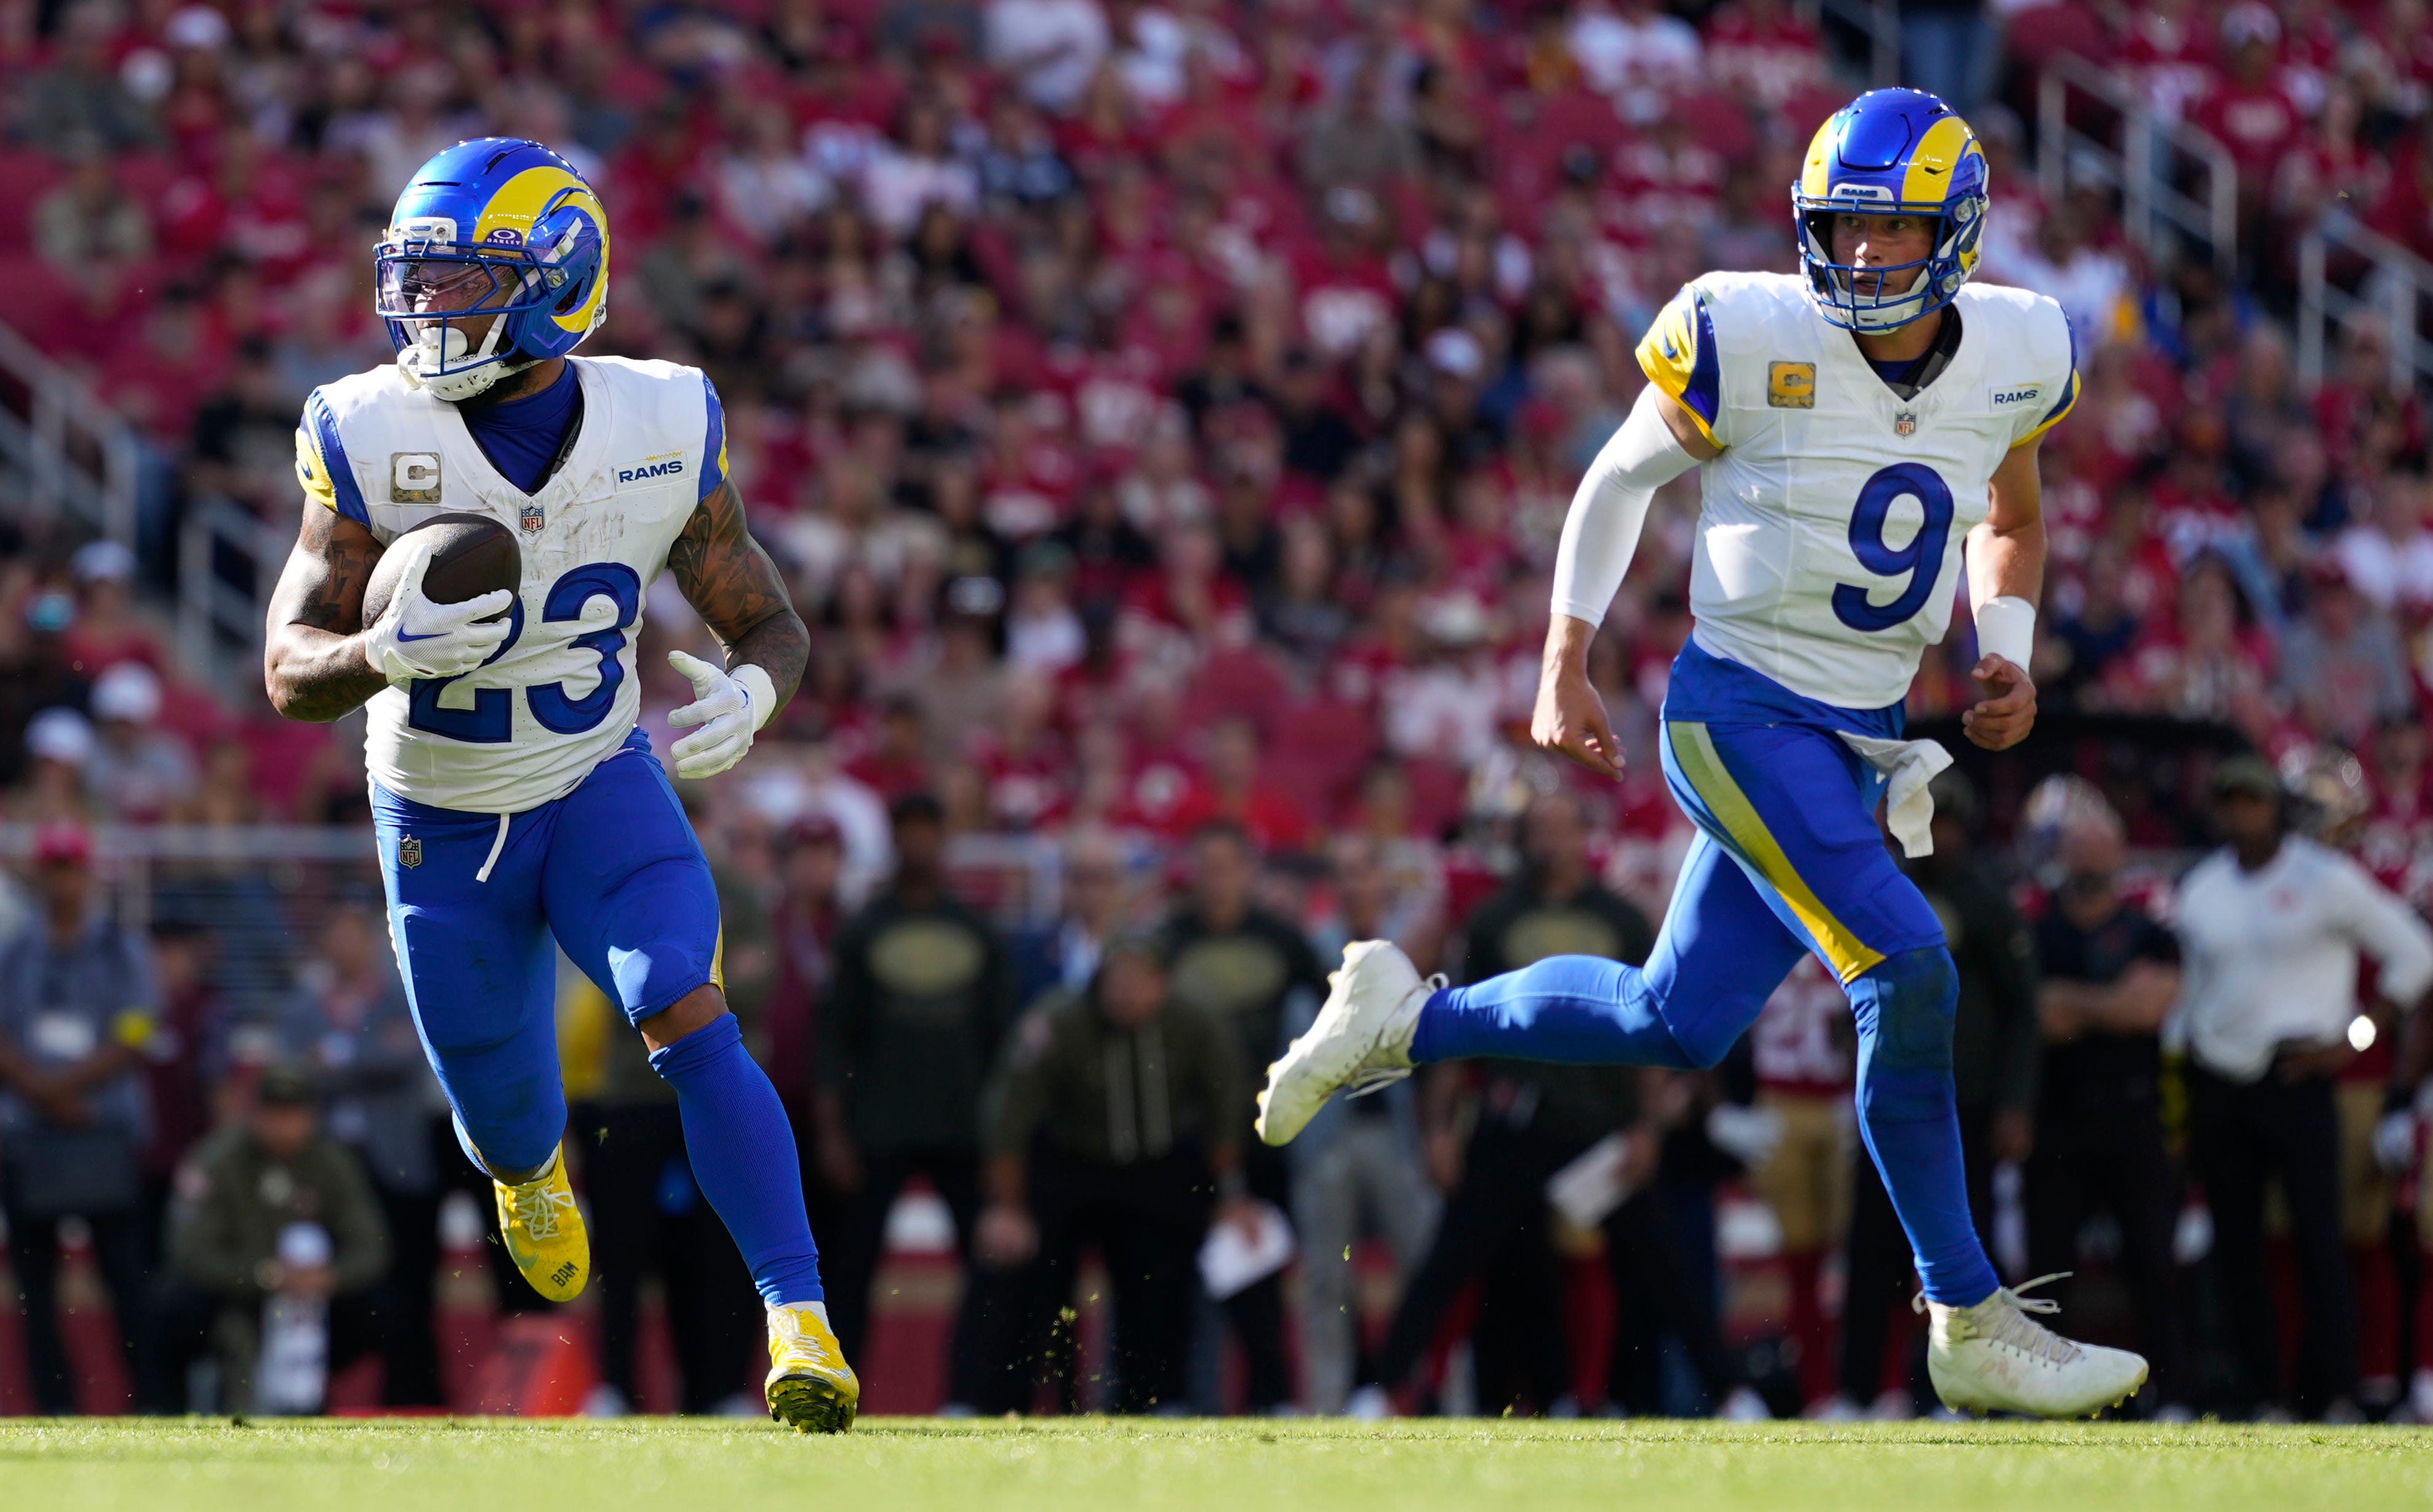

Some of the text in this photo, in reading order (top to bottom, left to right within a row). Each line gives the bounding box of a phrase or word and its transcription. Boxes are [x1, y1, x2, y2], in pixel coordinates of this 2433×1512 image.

[1841, 189, 1878, 197] RAMS
[1773, 364, 1813, 396] C
[1995, 390, 2038, 405] RAMS
[396, 455, 438, 490] C
[619, 461, 683, 483] RAMS
[524, 517, 542, 529] NFL
[1832, 463, 1954, 632] 9
[403, 852, 418, 862] NFL
[552, 1261, 579, 1287] BAM
